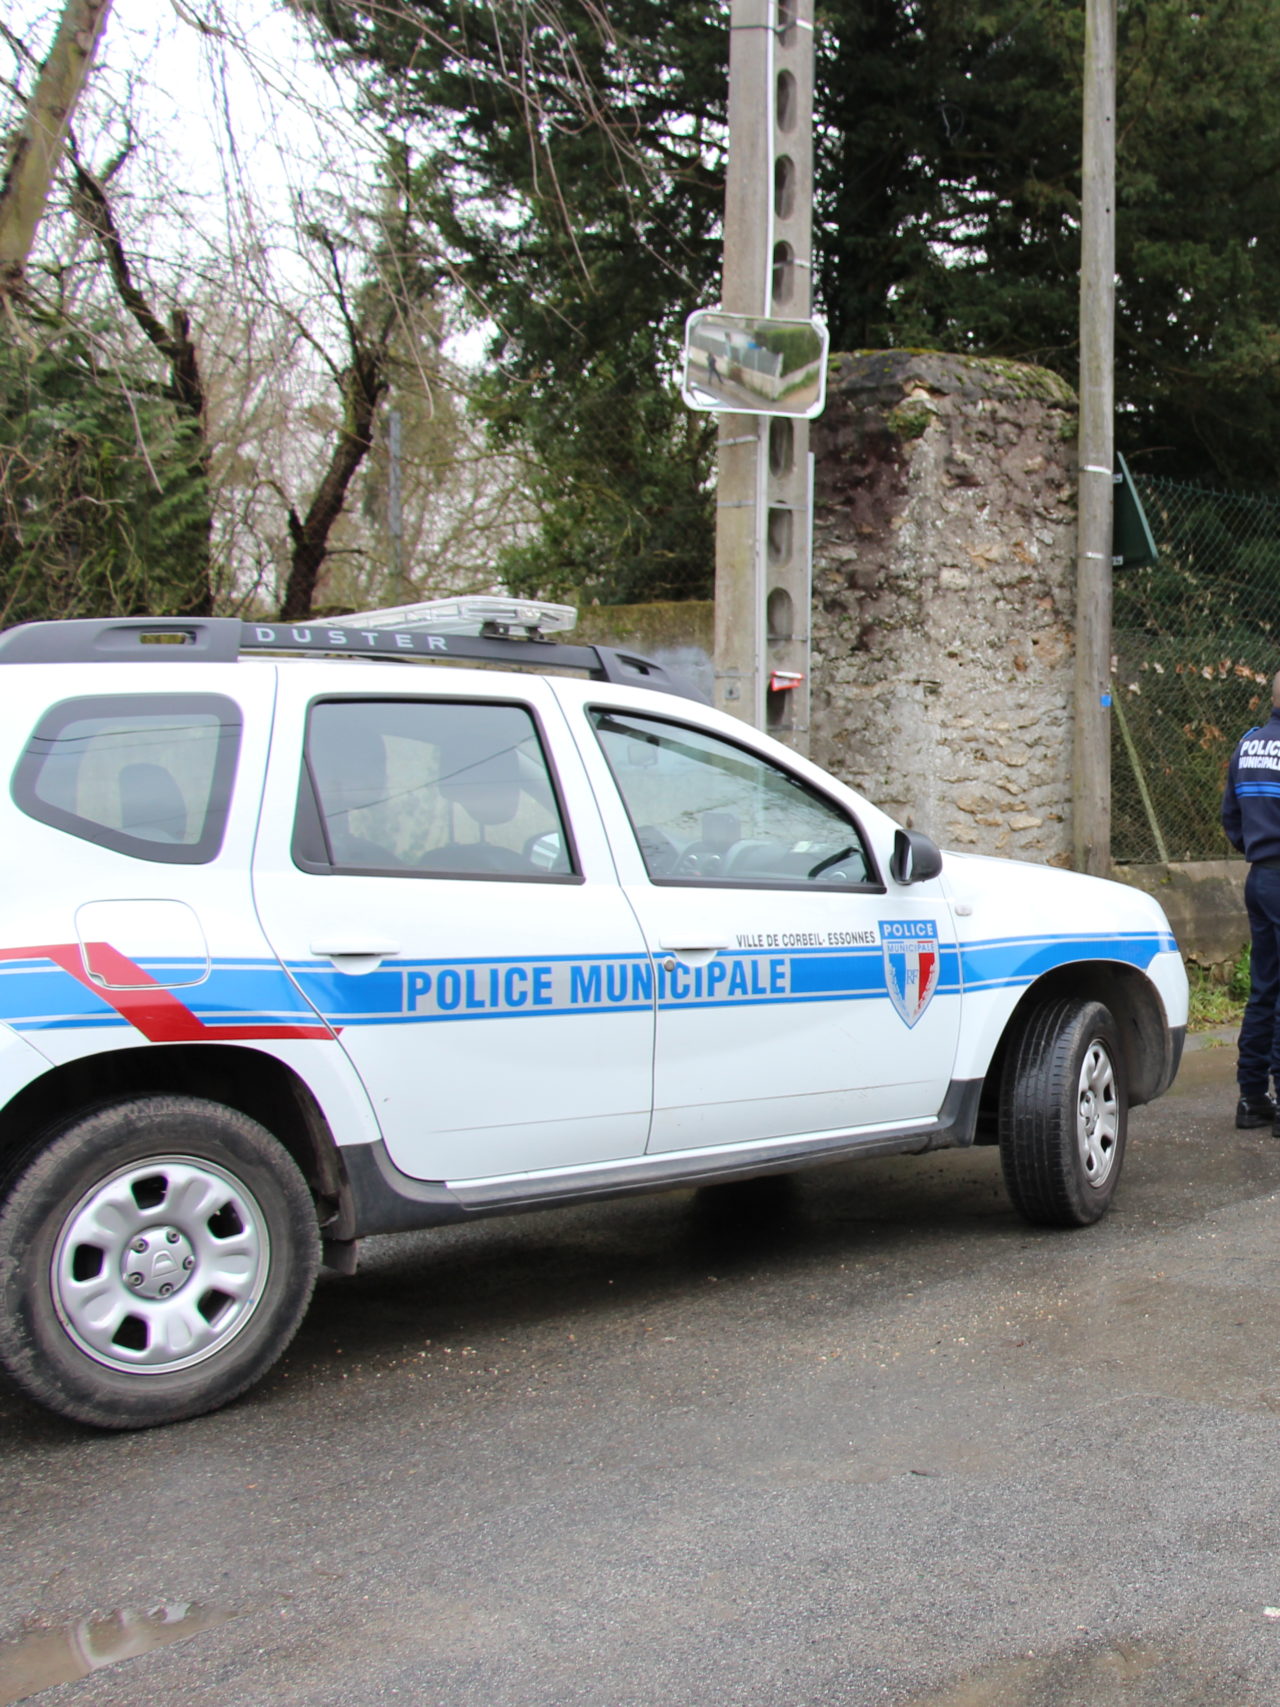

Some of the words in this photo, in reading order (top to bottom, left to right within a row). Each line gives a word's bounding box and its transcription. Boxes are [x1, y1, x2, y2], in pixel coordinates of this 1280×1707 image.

[255, 627, 448, 650] DUSTER
[883, 923, 934, 937] POLICE
[736, 934, 764, 948] VILLE
[766, 934, 780, 948] DE
[828, 931, 876, 946] ESSONNES
[887, 943, 935, 953] MUNICIPALE
[407, 965, 553, 1012] POLICE
[569, 958, 787, 1004] MUNICIPALE
[906, 968, 919, 985] RF
